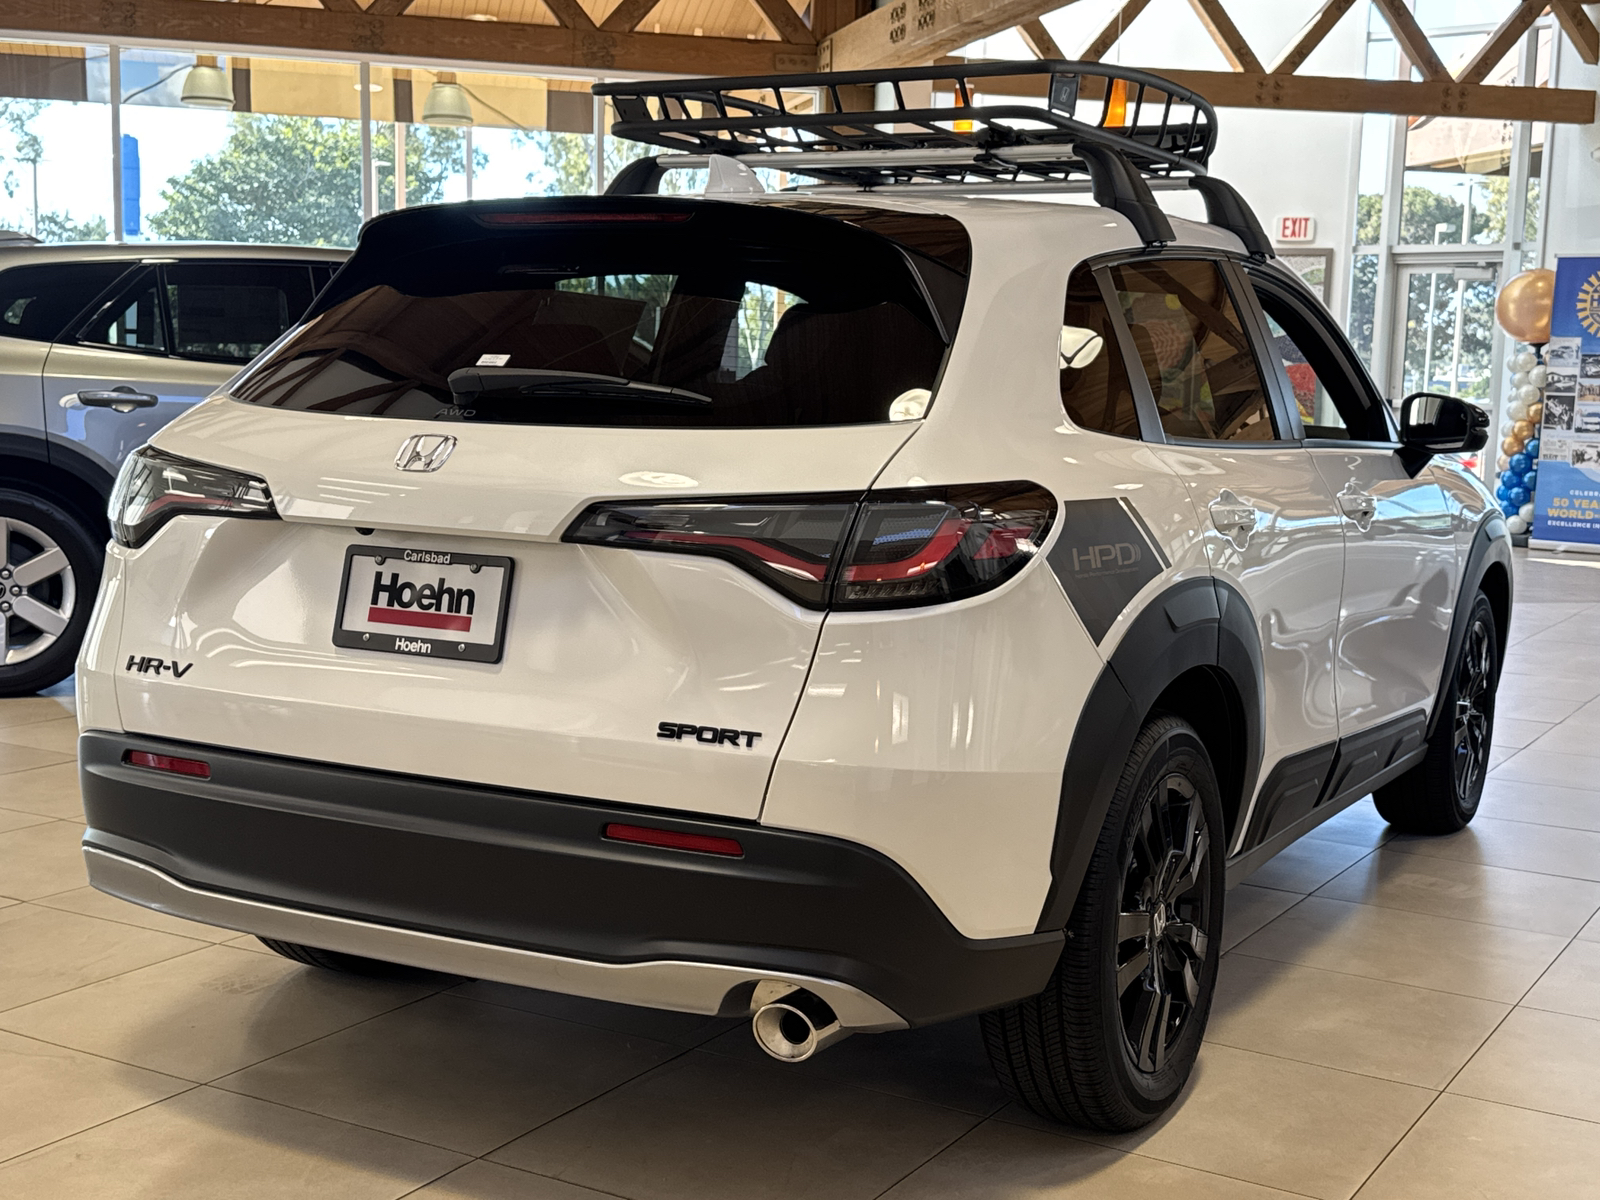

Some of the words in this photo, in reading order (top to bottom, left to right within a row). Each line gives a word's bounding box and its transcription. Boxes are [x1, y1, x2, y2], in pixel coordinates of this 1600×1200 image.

[1282, 217, 1310, 238] EXIT
[435, 408, 477, 417] AWD
[1569, 489, 1600, 497] CELEBR
[1553, 497, 1569, 507] 50
[1547, 519, 1591, 529] EXCELLENCE
[404, 550, 451, 564] Carlsbad
[1072, 543, 1140, 571] HPD
[370, 571, 475, 615] Hoehn
[395, 637, 432, 654] Hoehn
[125, 655, 194, 678] HR-V
[656, 721, 762, 748] SPORT
